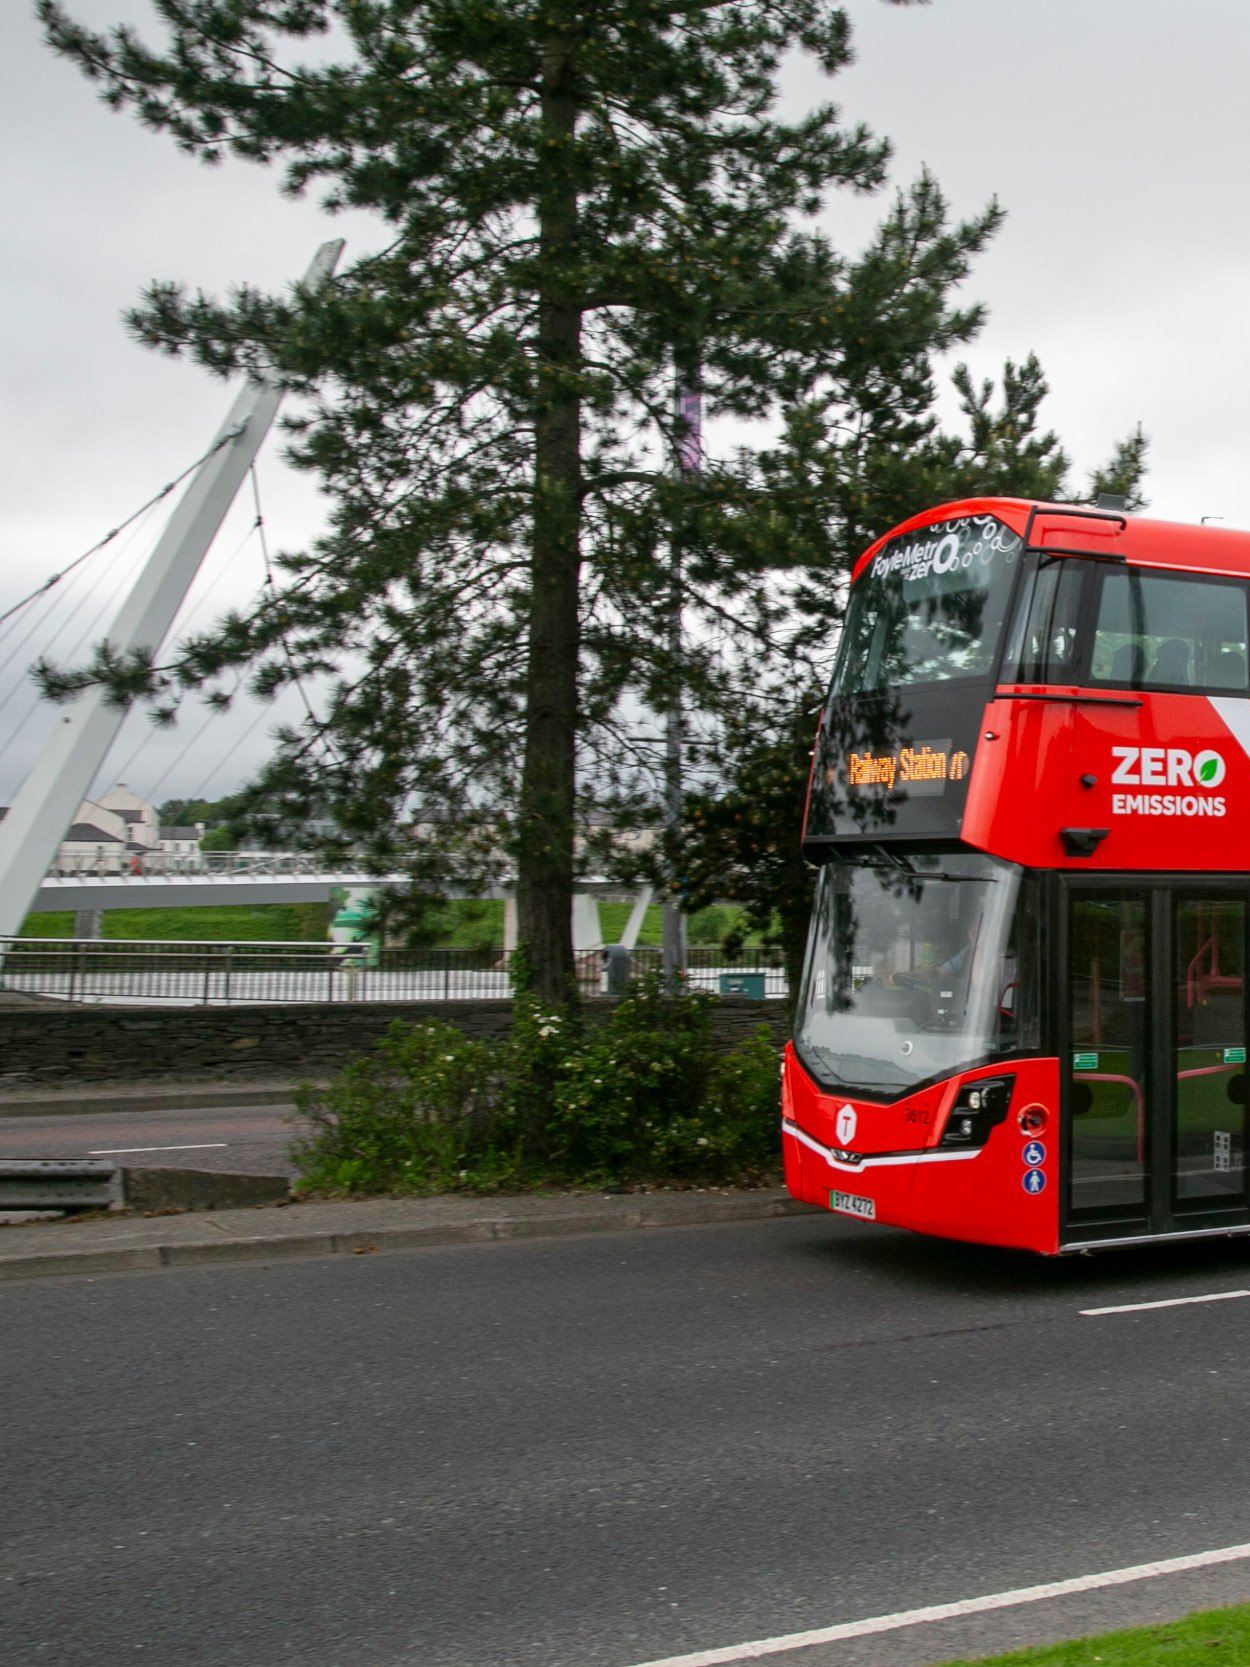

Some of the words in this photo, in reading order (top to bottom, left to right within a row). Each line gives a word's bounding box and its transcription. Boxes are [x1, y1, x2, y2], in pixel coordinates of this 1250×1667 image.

[899, 746, 947, 781] Station
[1111, 746, 1226, 788] ZERO
[1112, 794, 1226, 817] EMISSIONS
[904, 1107, 929, 1125] 3612
[834, 1191, 851, 1210] BYZ
[852, 1196, 874, 1216] 4272
